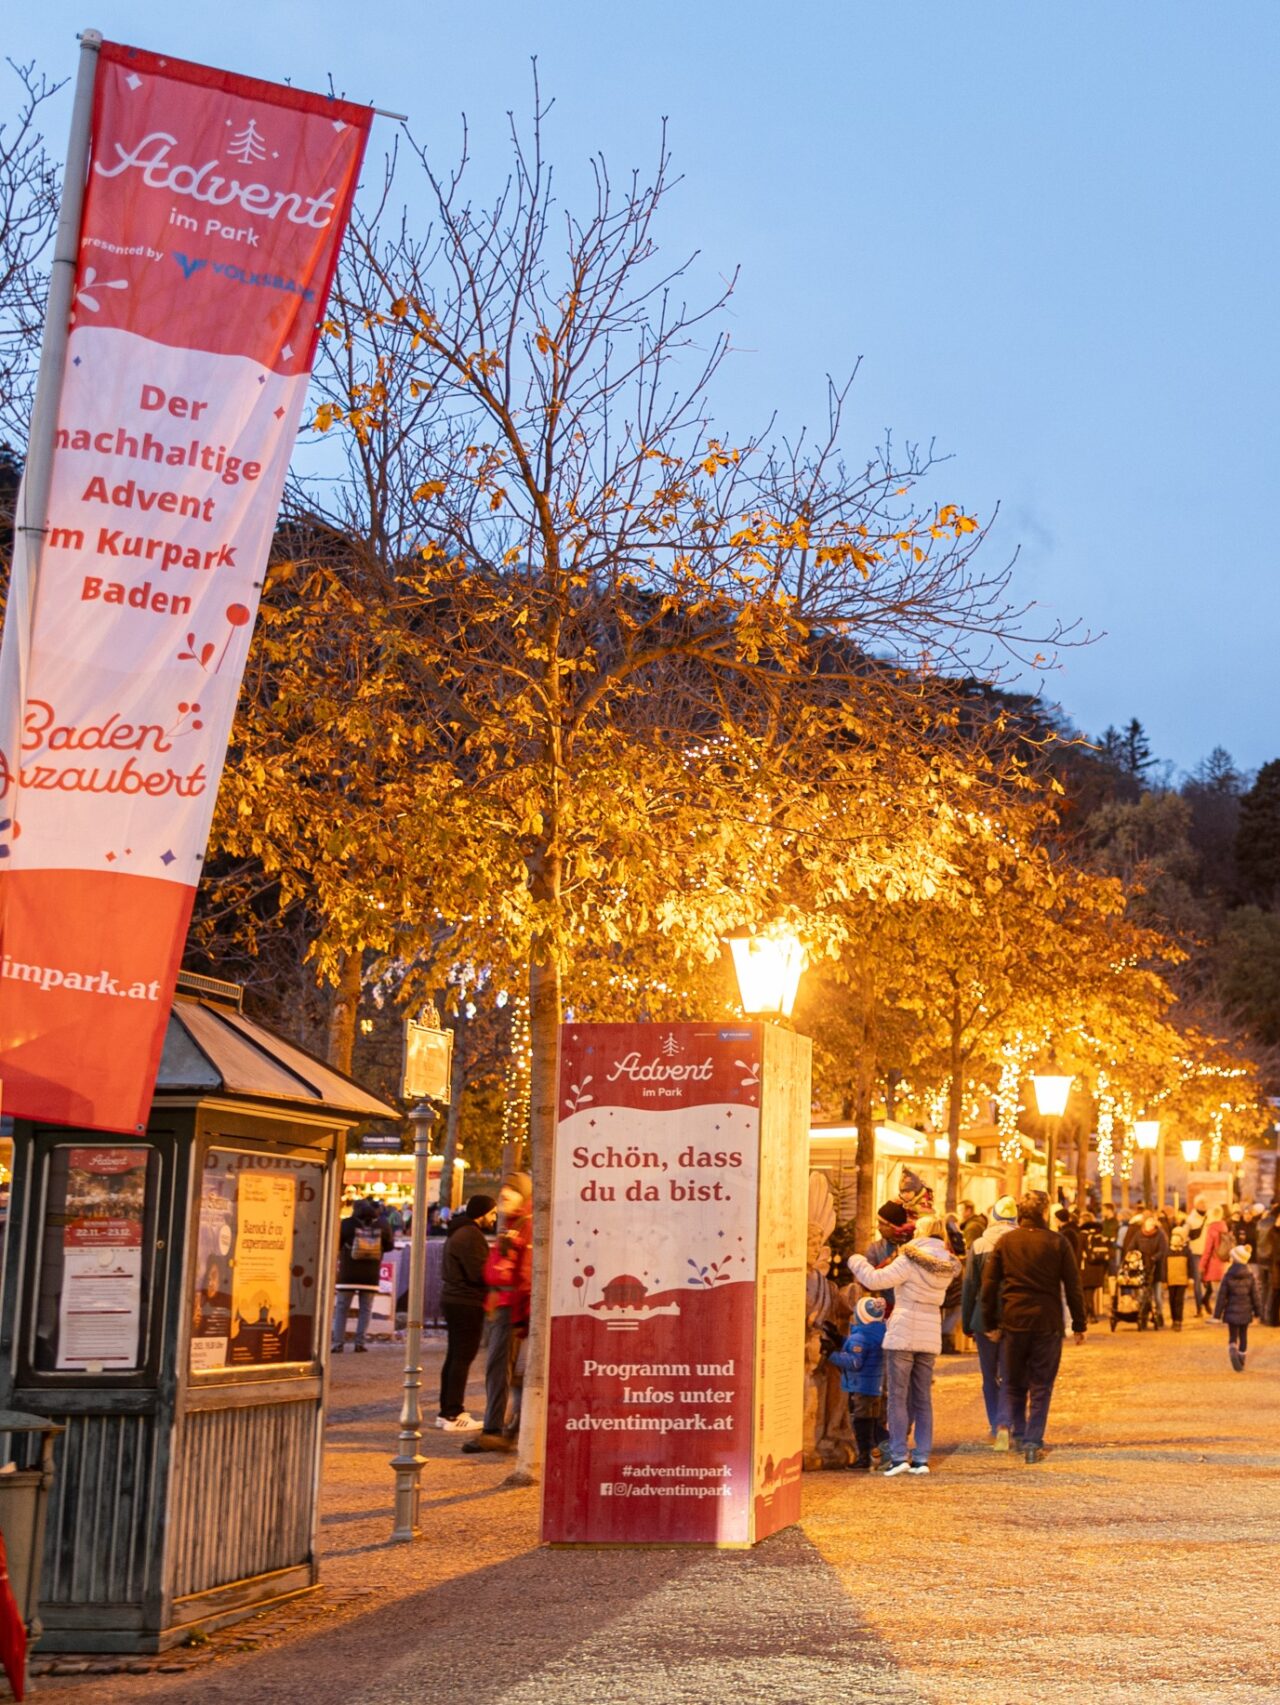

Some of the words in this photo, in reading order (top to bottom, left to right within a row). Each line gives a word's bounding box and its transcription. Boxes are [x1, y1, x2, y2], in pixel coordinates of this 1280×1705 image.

[94, 131, 337, 229] Advent
[169, 207, 199, 233] im
[204, 220, 261, 248] Park
[82, 237, 144, 256] presented
[147, 247, 164, 263] by
[211, 262, 315, 303] VOLKSBAK
[139, 384, 208, 421] Der
[54, 427, 262, 485] nachhaltige
[82, 476, 215, 522] Advent
[47, 521, 84, 550] m
[96, 528, 237, 571] Kurpark
[81, 576, 192, 615] Baden
[21, 699, 172, 752] Baden
[1, 954, 161, 1001] impark.at
[606, 1051, 714, 1082] Advent
[642, 1087, 656, 1097] im
[658, 1087, 683, 1097] Park
[572, 1146, 668, 1172] Schön,
[678, 1146, 742, 1168] dass
[580, 1180, 615, 1202] du
[625, 1180, 660, 1202] da
[669, 1180, 732, 1202] bist.
[583, 1360, 691, 1380] Programm
[695, 1360, 735, 1377] und
[622, 1387, 674, 1404] Infos
[679, 1389, 735, 1404] unter
[565, 1414, 734, 1434] adventimpark.at
[622, 1465, 732, 1479] #adventimpark
[626, 1482, 732, 1498] /adventimpark
